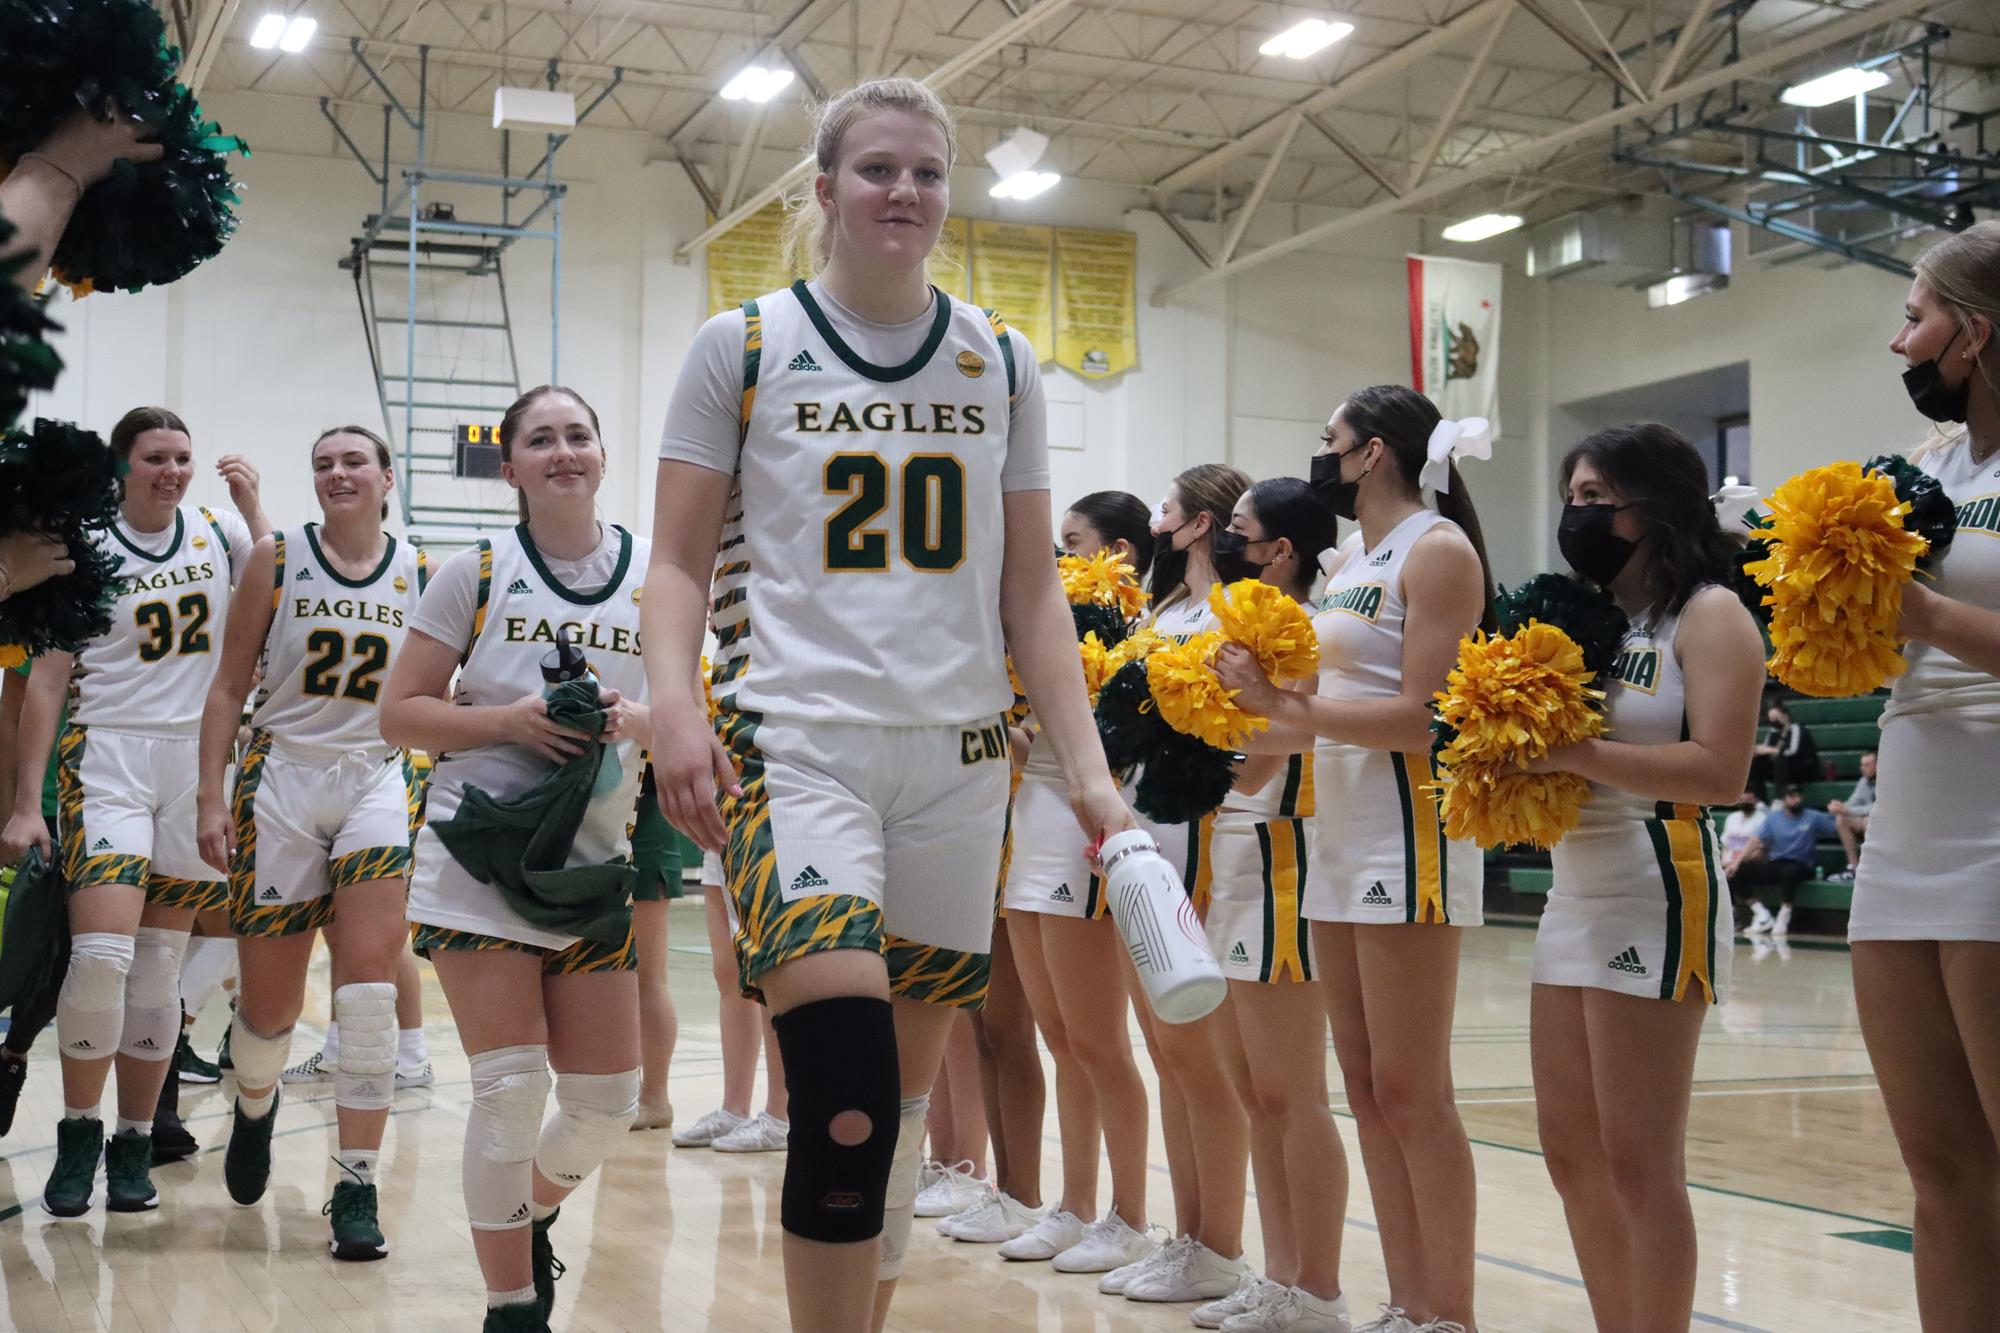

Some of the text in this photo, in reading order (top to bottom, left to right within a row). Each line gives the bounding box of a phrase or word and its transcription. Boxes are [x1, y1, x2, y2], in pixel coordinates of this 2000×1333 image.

[788, 363, 823, 372] adidas
[793, 402, 986, 435] EAGLES
[822, 451, 967, 574] 20
[134, 591, 212, 664] 32
[294, 598, 404, 629] EAGLES
[303, 627, 391, 705] 22
[1611, 651, 1658, 690] DIA
[791, 877, 829, 891] adidas
[1362, 895, 1392, 905] adidas
[1608, 960, 1647, 974] adidas
